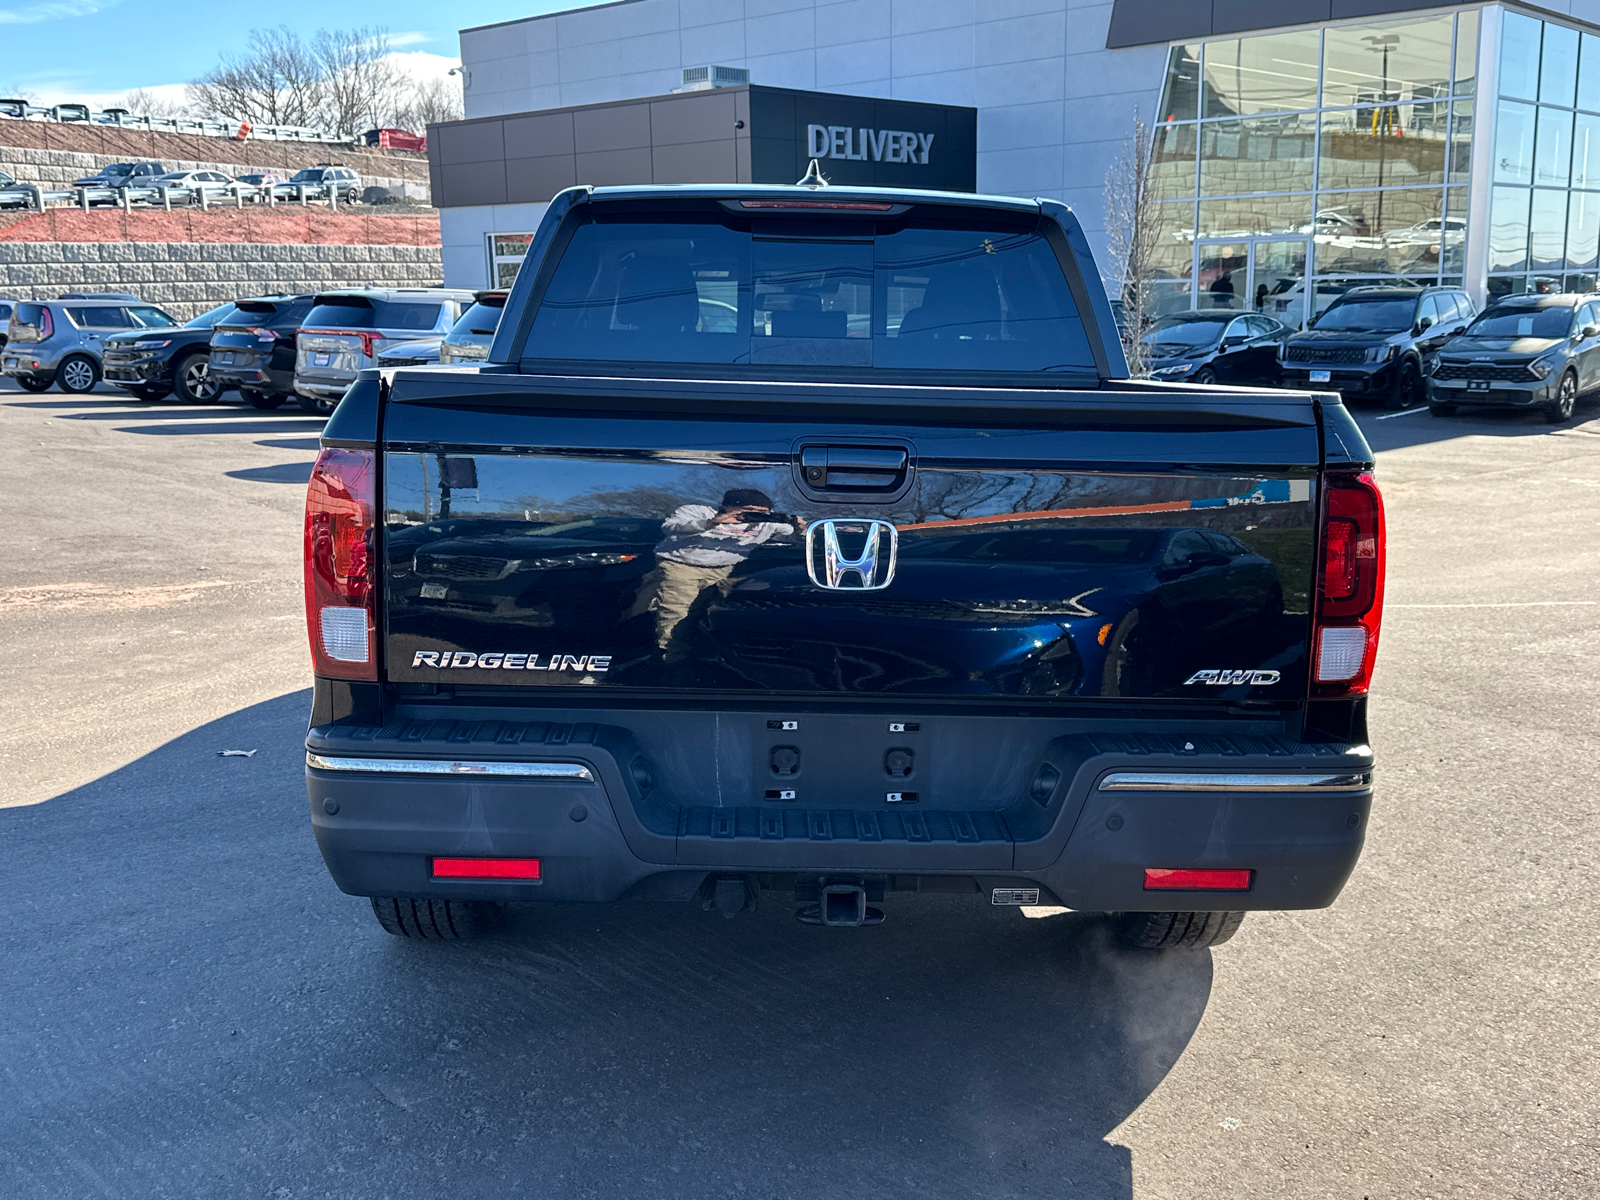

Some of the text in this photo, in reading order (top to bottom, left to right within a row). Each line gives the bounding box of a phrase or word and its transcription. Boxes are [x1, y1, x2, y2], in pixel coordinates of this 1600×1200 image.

[807, 124, 935, 165] DELIVERY
[411, 650, 613, 672] RIDGELINE
[1183, 669, 1281, 685] AWD
